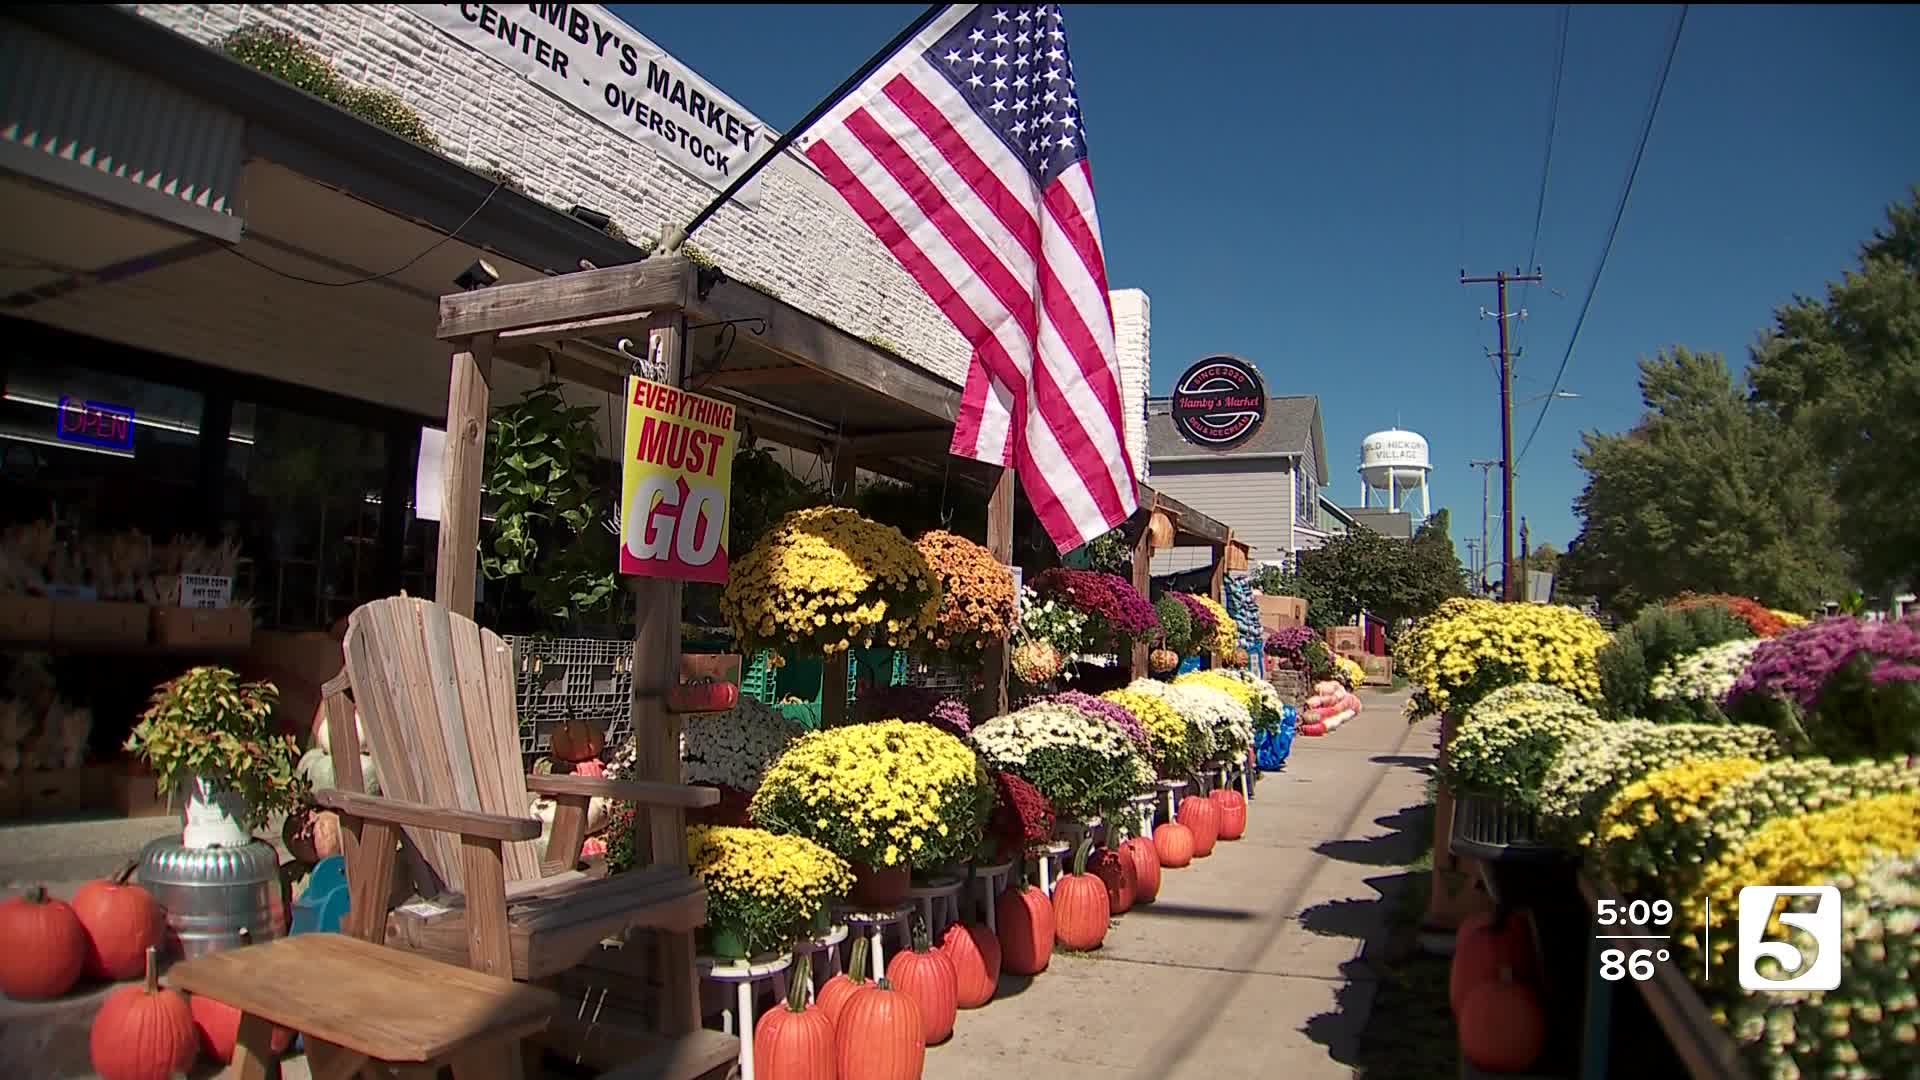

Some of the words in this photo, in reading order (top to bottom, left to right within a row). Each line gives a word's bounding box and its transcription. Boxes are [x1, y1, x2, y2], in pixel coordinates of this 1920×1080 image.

[460, 4, 568, 79] CENTER
[604, 83, 730, 177] OVERSTOCK
[647, 61, 755, 153] MARKET
[1193, 368, 1220, 385] SINCE
[63, 398, 129, 440] OPEN
[633, 380, 734, 432] EVERYTHING
[1180, 396, 1222, 410] Hamby's
[1225, 396, 1259, 408] Market
[1189, 416, 1202, 431] DELI
[1224, 416, 1249, 435] CREAM
[637, 415, 724, 477] MUST
[1376, 450, 1417, 459] VILLAGE
[627, 476, 726, 567] GO
